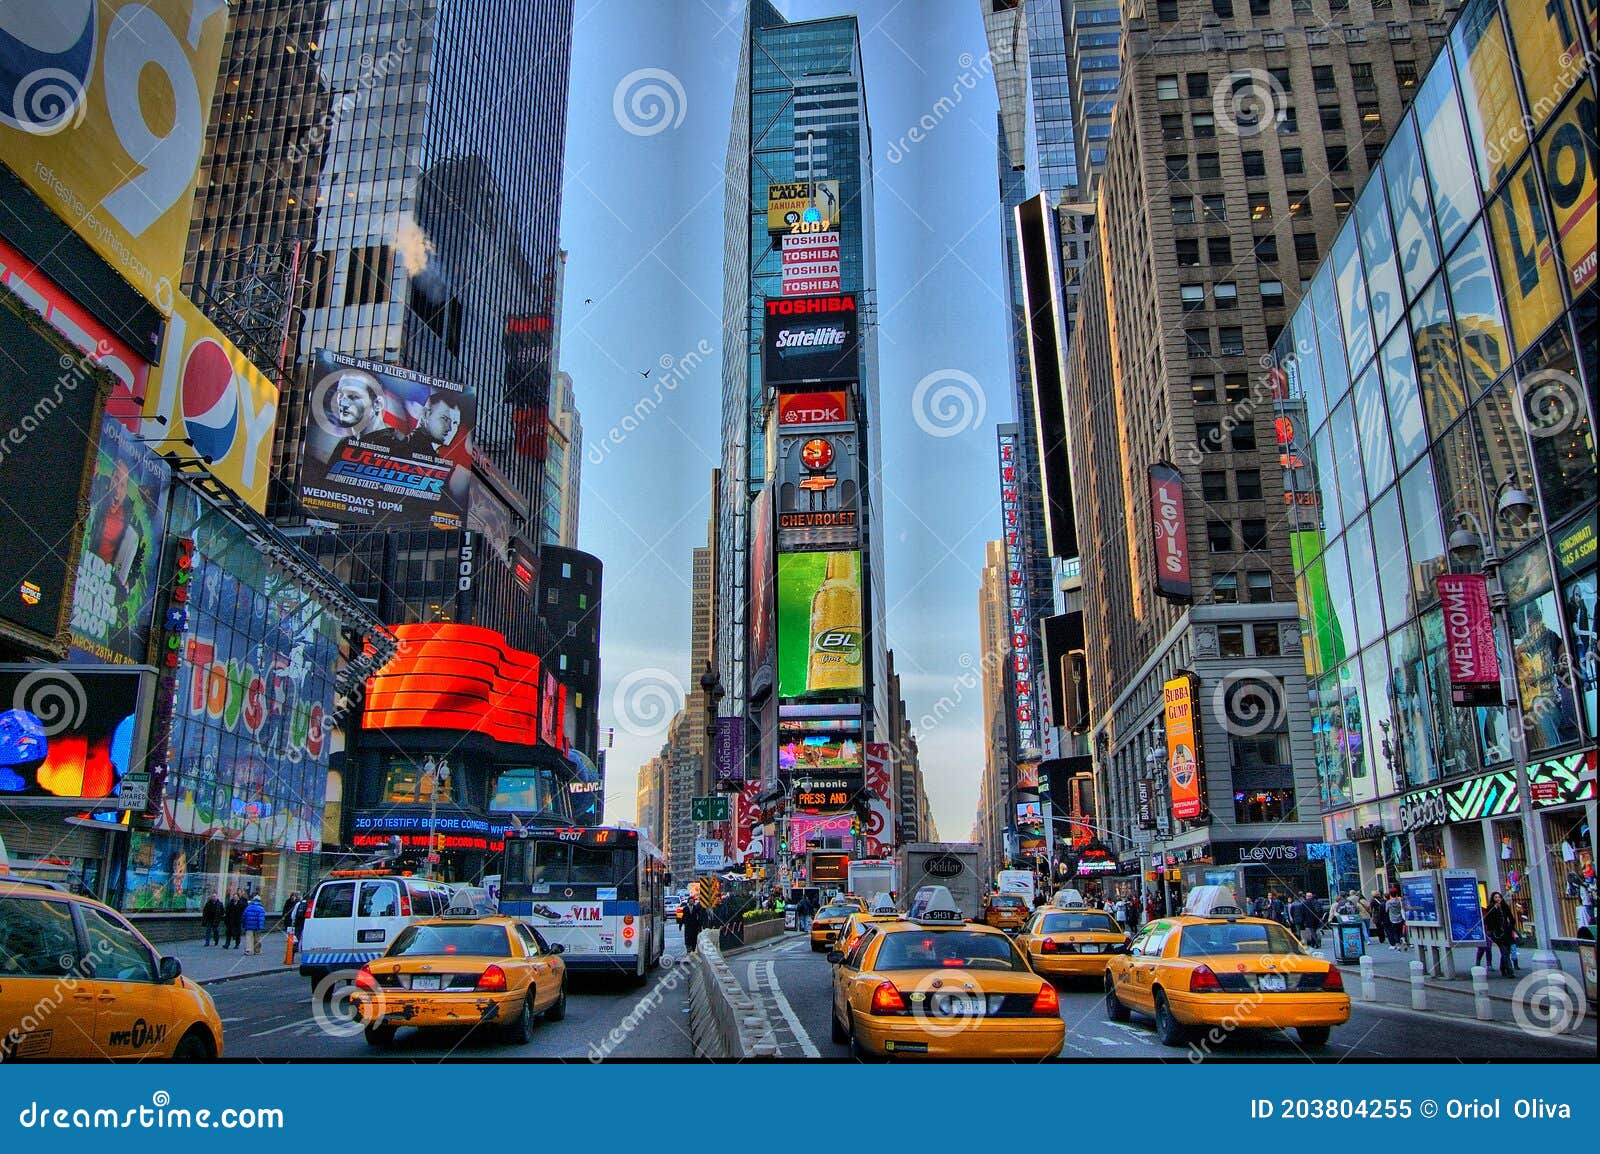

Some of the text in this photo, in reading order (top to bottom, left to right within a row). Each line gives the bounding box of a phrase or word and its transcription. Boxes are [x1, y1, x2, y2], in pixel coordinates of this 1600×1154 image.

[769, 184, 797, 193] MAKE
[769, 200, 806, 211] JANUARY
[34, 159, 153, 286] refresheverything.com
[791, 219, 830, 234] 2009
[784, 234, 838, 246] TOSHIBA
[784, 249, 838, 261] TOSHIBA
[784, 264, 838, 276] TOSHIBA
[784, 280, 839, 292] TOSHIBA
[766, 296, 855, 316] TOSHIBA
[775, 327, 847, 348] Satellite
[332, 353, 464, 393] THERE ARE NO ALLIES IN THE OCTAGON
[797, 407, 840, 421] TDK
[348, 439, 391, 454] DAN HENDERSON
[341, 446, 450, 480] ULTIMATE
[328, 460, 445, 494] FIGHTER
[335, 473, 357, 486] UNITED
[357, 477, 381, 490] STATES
[302, 486, 403, 513] WEDNESDAYS 10PM
[302, 496, 347, 511] PREMIERES
[347, 505, 370, 515] APRIL
[430, 515, 462, 528] SPIKE
[781, 512, 855, 528] CHEVROLET
[458, 531, 473, 591] 1500
[175, 538, 195, 603] TOYS
[1002, 445, 1017, 547] ERNST
[1012, 608, 1030, 722] YOUNG
[1444, 581, 1475, 679] WELCOME
[822, 633, 857, 647] BL
[95, 643, 114, 663] 28TH
[164, 633, 182, 668] US
[186, 633, 268, 734] TOYS
[1165, 685, 1189, 704] BUBBA
[1168, 703, 1189, 720] GUMP
[794, 780, 848, 789] Panasonic
[1138, 781, 1148, 802] VENIT
[120, 792, 147, 800] SHARED
[799, 793, 847, 804] PRESS AND
[1140, 802, 1149, 821] BUN
[373, 818, 383, 828] TO
[384, 817, 419, 828] TESTIFY
[421, 818, 459, 828] BEFORE
[559, 831, 582, 841] 6707
[573, 906, 603, 921] V.I.M.
[933, 911, 951, 920] 5H31
[108, 1018, 166, 1049] NYC TAXI
